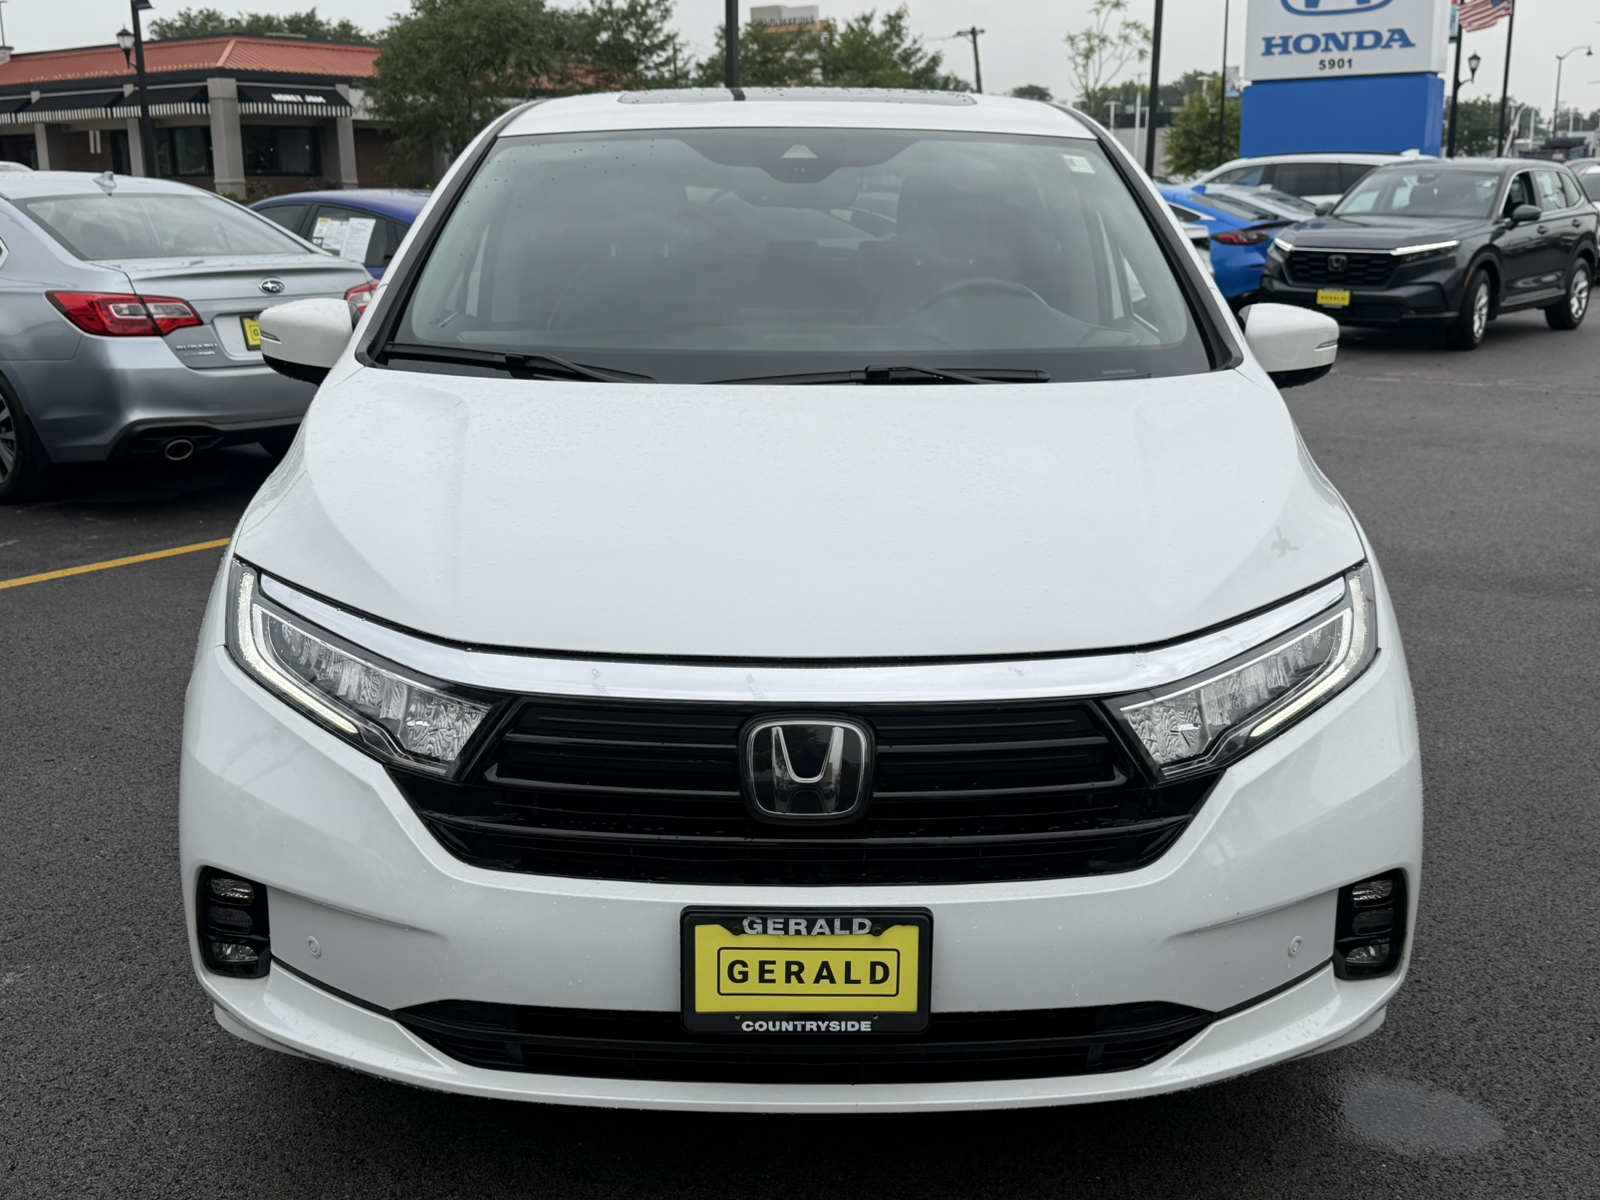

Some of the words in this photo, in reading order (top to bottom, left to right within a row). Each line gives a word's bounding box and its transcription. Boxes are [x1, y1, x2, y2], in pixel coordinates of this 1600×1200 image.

[1261, 28, 1416, 57] HONDA
[1318, 58, 1353, 71] 5901
[742, 916, 872, 936] GERALD
[726, 959, 890, 985] GERALD
[741, 1020, 872, 1032] COUNTRYSIDE
